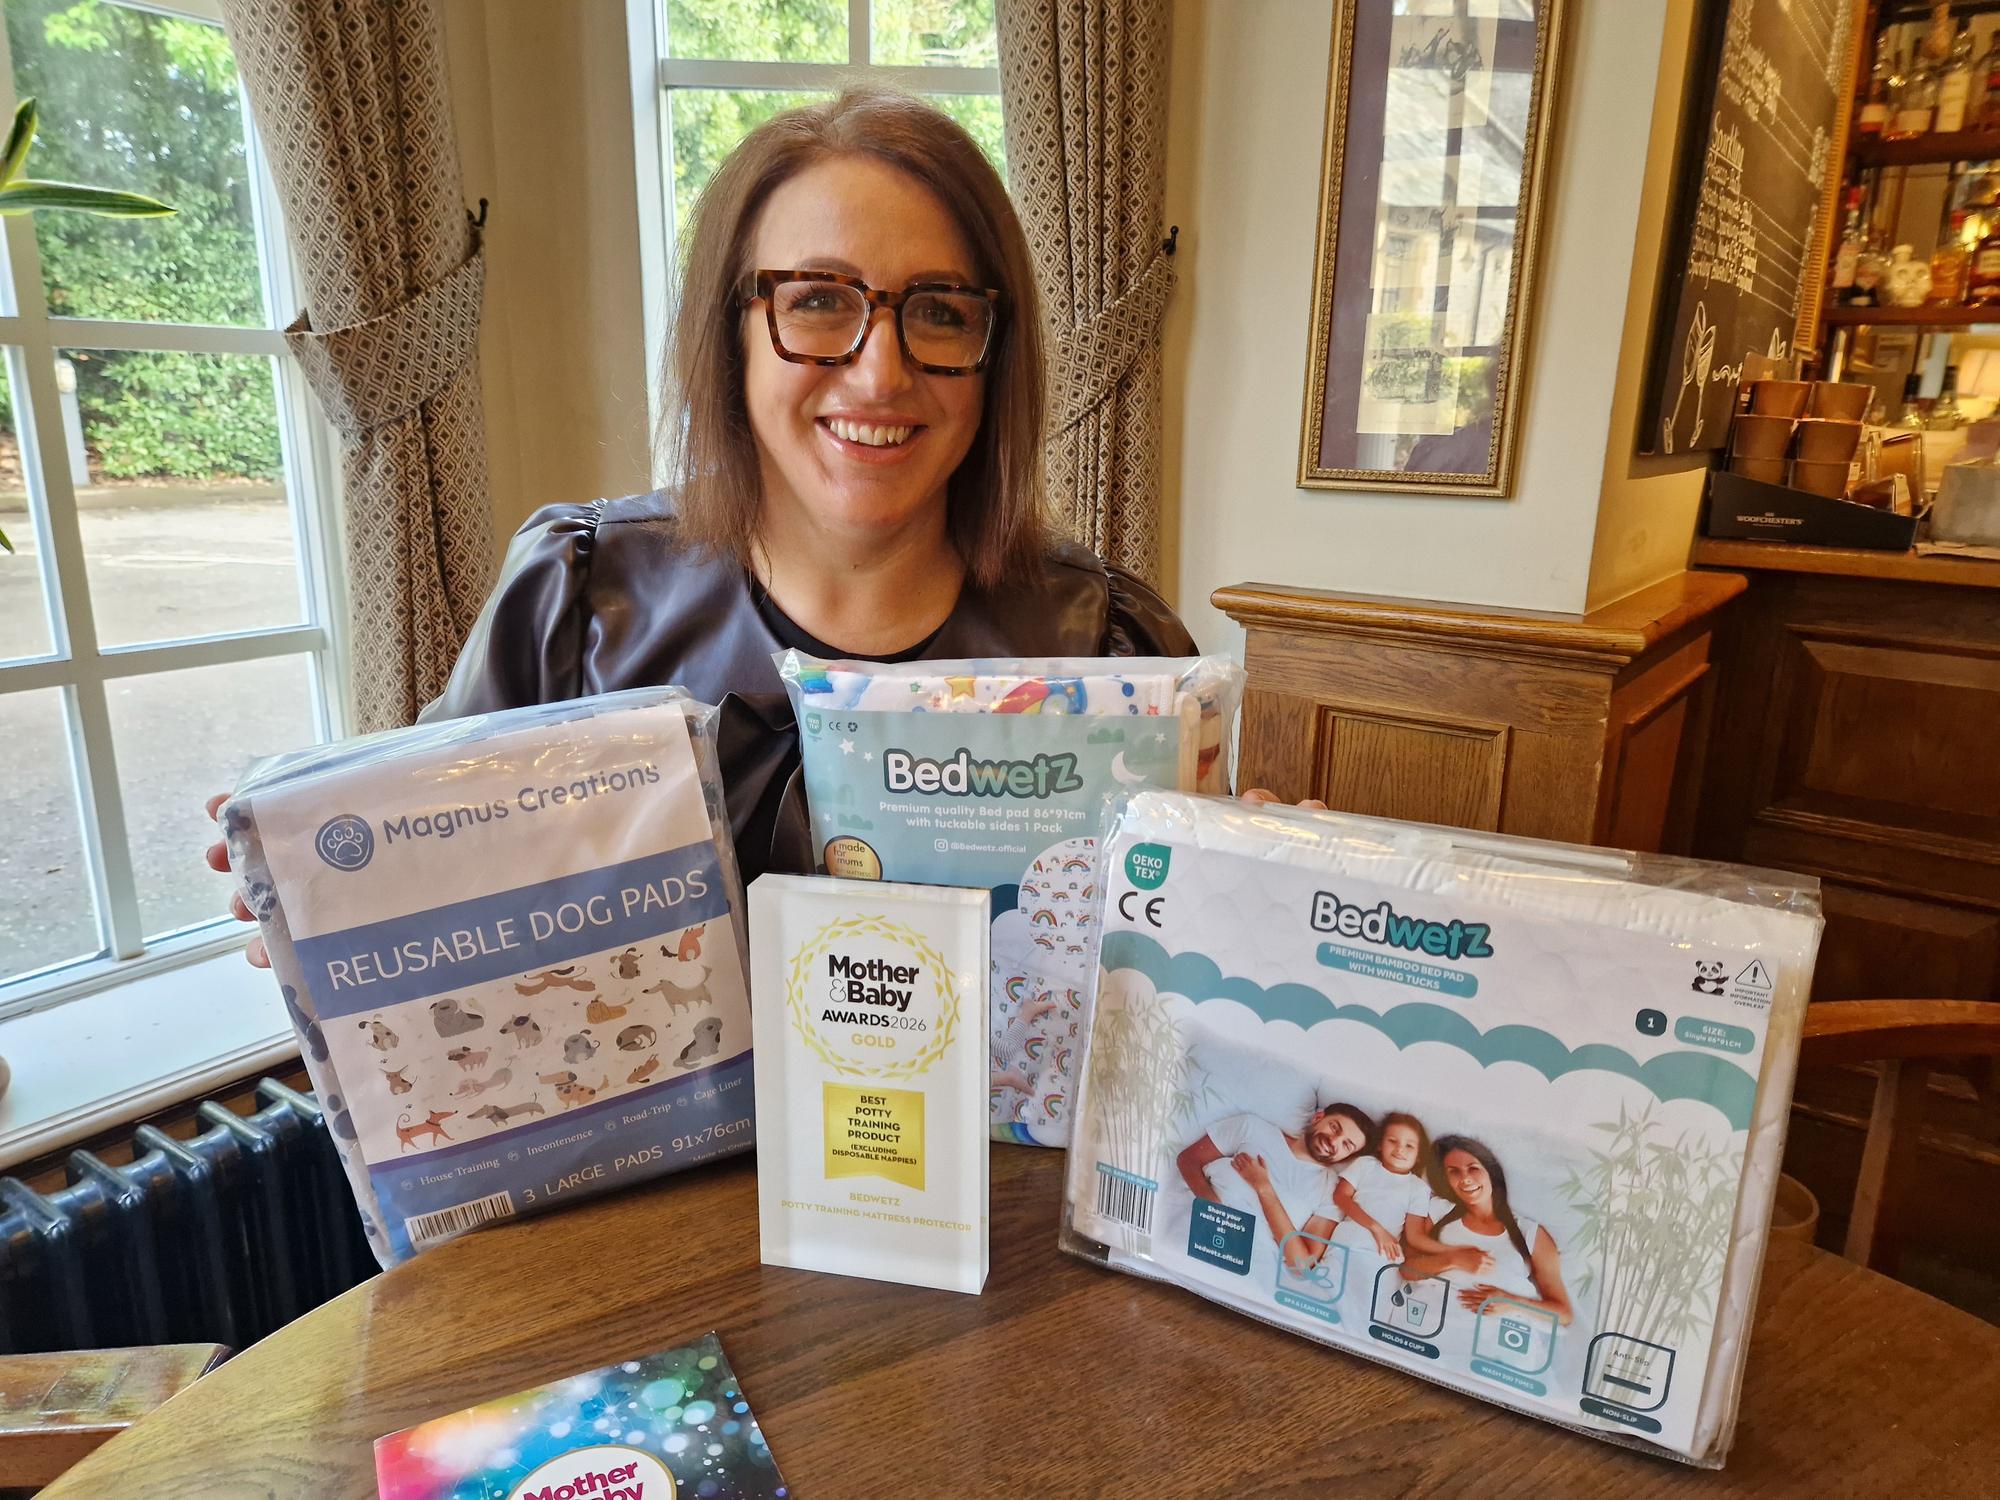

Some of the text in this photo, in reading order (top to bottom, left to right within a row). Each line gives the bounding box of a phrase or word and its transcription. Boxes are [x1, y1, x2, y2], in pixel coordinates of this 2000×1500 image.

[883, 747, 1084, 800] Bedwetz
[383, 765, 660, 844] Magnus Creations
[879, 801, 930, 814] Premium
[934, 805, 975, 819] quality
[979, 806, 1002, 817] Bed
[1006, 807, 1029, 819] pad
[906, 817, 1063, 834] with tuckable sides 1 Pack
[838, 842, 866, 853] made
[837, 857, 864, 867] mums
[1132, 853, 1163, 869] OEKO
[1118, 891, 1166, 928] CE
[326, 869, 708, 991] REUSABLE DOG PADS
[1310, 890, 1495, 961] Bedwetz
[828, 954, 920, 984] Mother
[1329, 945, 1465, 982] PREMIUM BAMBOO BED PAD
[1349, 961, 1441, 990] WITH WING TUCKS
[1647, 1017, 1655, 1028] 1
[1684, 1031, 1707, 1042] Single
[1702, 1025, 1727, 1038] SIZE:
[851, 1033, 896, 1048] GOLD
[693, 1077, 743, 1102] Cage Liner
[860, 1095, 887, 1106] BEST
[622, 1102, 672, 1126] Road-Trip
[855, 1106, 892, 1118] POTTY
[848, 1118, 901, 1131] TRAINING
[847, 1129, 901, 1144] PRODUCT
[832, 1149, 917, 1166] DISPOSABLE NAPPIES)
[850, 1144, 898, 1155] (EXCLUDING
[523, 1118, 751, 1204] 3 LARGE PADS 91x76cm
[420, 1157, 501, 1186] House Training
[849, 1192, 901, 1206] BEDWETZ
[781, 1199, 972, 1232] POTTY TRAINING MATTRESS PROTECTOR
[1207, 1205, 1242, 1221] Share your
[1200, 1213, 1245, 1232] reels & photo's
[1411, 1307, 1419, 1315] 8
[1381, 1332, 1404, 1344] HOLDS
[1408, 1342, 1426, 1352] CUPS
[1602, 1407, 1638, 1423] NON-SLIP
